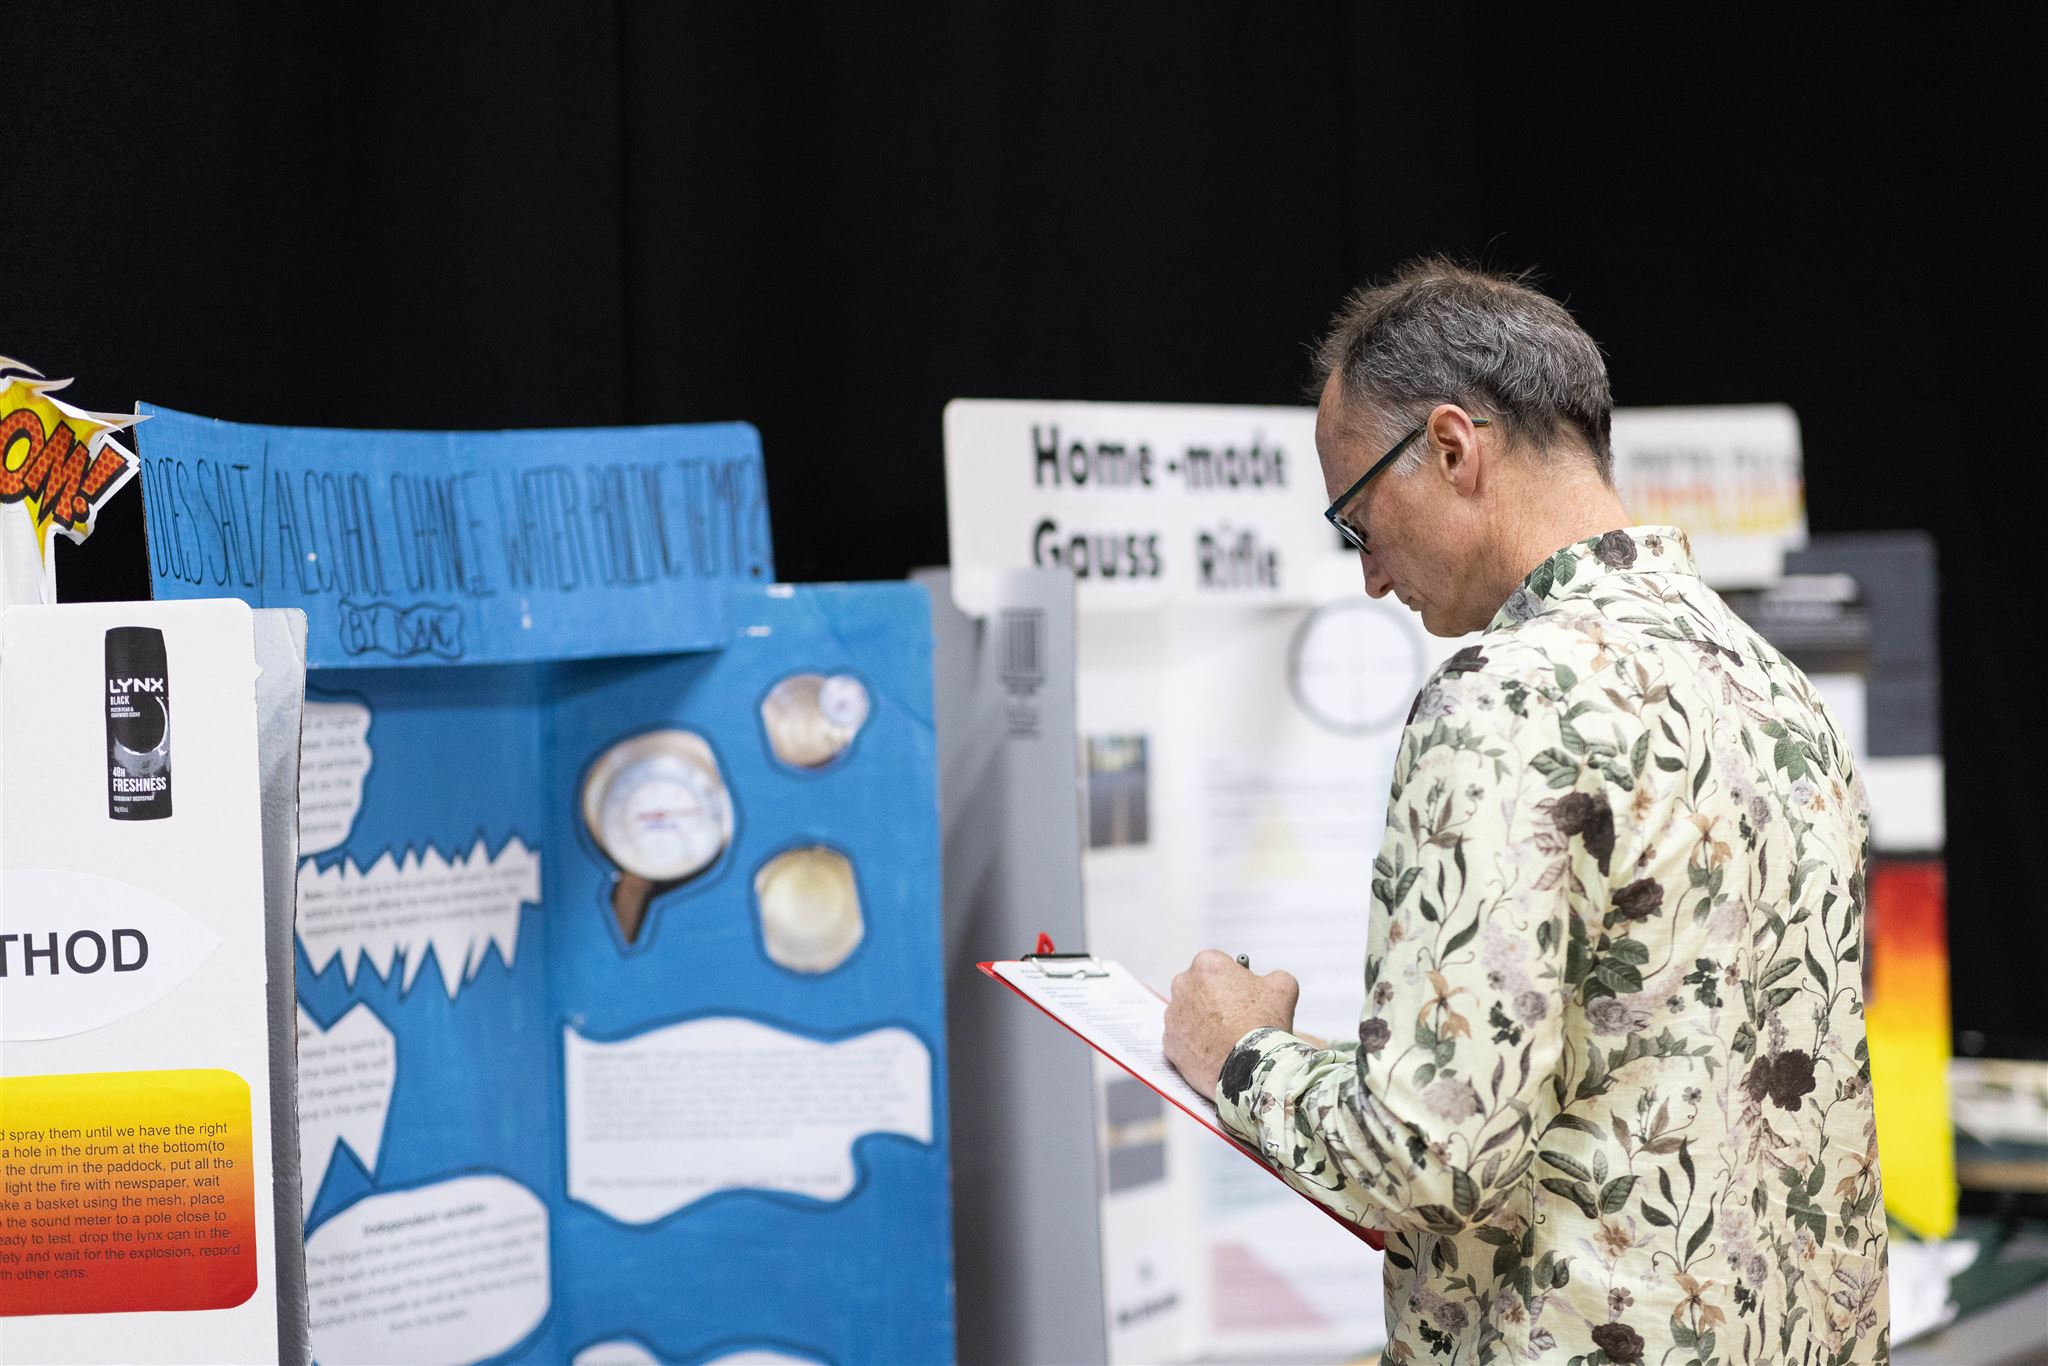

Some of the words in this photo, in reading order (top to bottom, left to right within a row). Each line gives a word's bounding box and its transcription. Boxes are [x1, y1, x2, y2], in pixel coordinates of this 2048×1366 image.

[144, 458, 203, 586] DOES
[1198, 522, 1279, 589] Rifle
[350, 609, 380, 650] BY
[109, 678, 164, 694] LYNX
[110, 696, 130, 706] BLACK
[112, 766, 126, 778] 48H
[113, 777, 167, 793] FRESHNESS
[9, 1131, 45, 1143] spray
[49, 1128, 81, 1139] them
[86, 1126, 112, 1138] until
[116, 1127, 135, 1137] we
[139, 1125, 170, 1136] have
[175, 1123, 195, 1135] the
[200, 1122, 228, 1137] right
[2, 1149, 9, 1159] a
[14, 1146, 41, 1158] hole
[45, 1145, 57, 1157] in
[61, 1145, 81, 1156] the
[85, 1144, 118, 1156] drum
[122, 1143, 135, 1154] at
[139, 1142, 159, 1153] the
[6, 1164, 26, 1176] the
[30, 1163, 63, 1175] drum
[67, 1162, 79, 1174] in
[83, 1161, 103, 1173] the
[107, 1160, 166, 1175] paddock,
[170, 1159, 191, 1172] put
[195, 1158, 209, 1170] all
[213, 1157, 234, 1169] the
[5, 1181, 33, 1196] light
[36, 1181, 56, 1192] the
[60, 1179, 81, 1191] fire
[85, 1179, 111, 1191] with
[193, 1175, 220, 1187] wait
[24, 1201, 32, 1210] a
[36, 1198, 79, 1210] basket
[83, 1197, 118, 1210] using
[122, 1195, 142, 1207] the
[190, 1193, 225, 1207] place
[7, 1216, 27, 1228] the
[31, 1215, 71, 1227] sound
[75, 1214, 112, 1226] meter
[116, 1213, 128, 1224] to
[132, 1214, 140, 1224] a
[144, 1212, 172, 1226] pole
[176, 1211, 210, 1222] close
[214, 1210, 227, 1221] to
[32, 1233, 44, 1245] to
[79, 1231, 109, 1246] drop
[112, 1230, 132, 1242] the
[136, 1230, 163, 1244] lynx
[167, 1230, 191, 1241] can
[194, 1228, 206, 1239] in
[210, 1227, 230, 1239] the
[26, 1249, 50, 1262] and
[54, 1249, 80, 1261] wait
[84, 1248, 101, 1260] for
[105, 1248, 125, 1260] the
[199, 1243, 241, 1257] record
[16, 1268, 50, 1281] other
